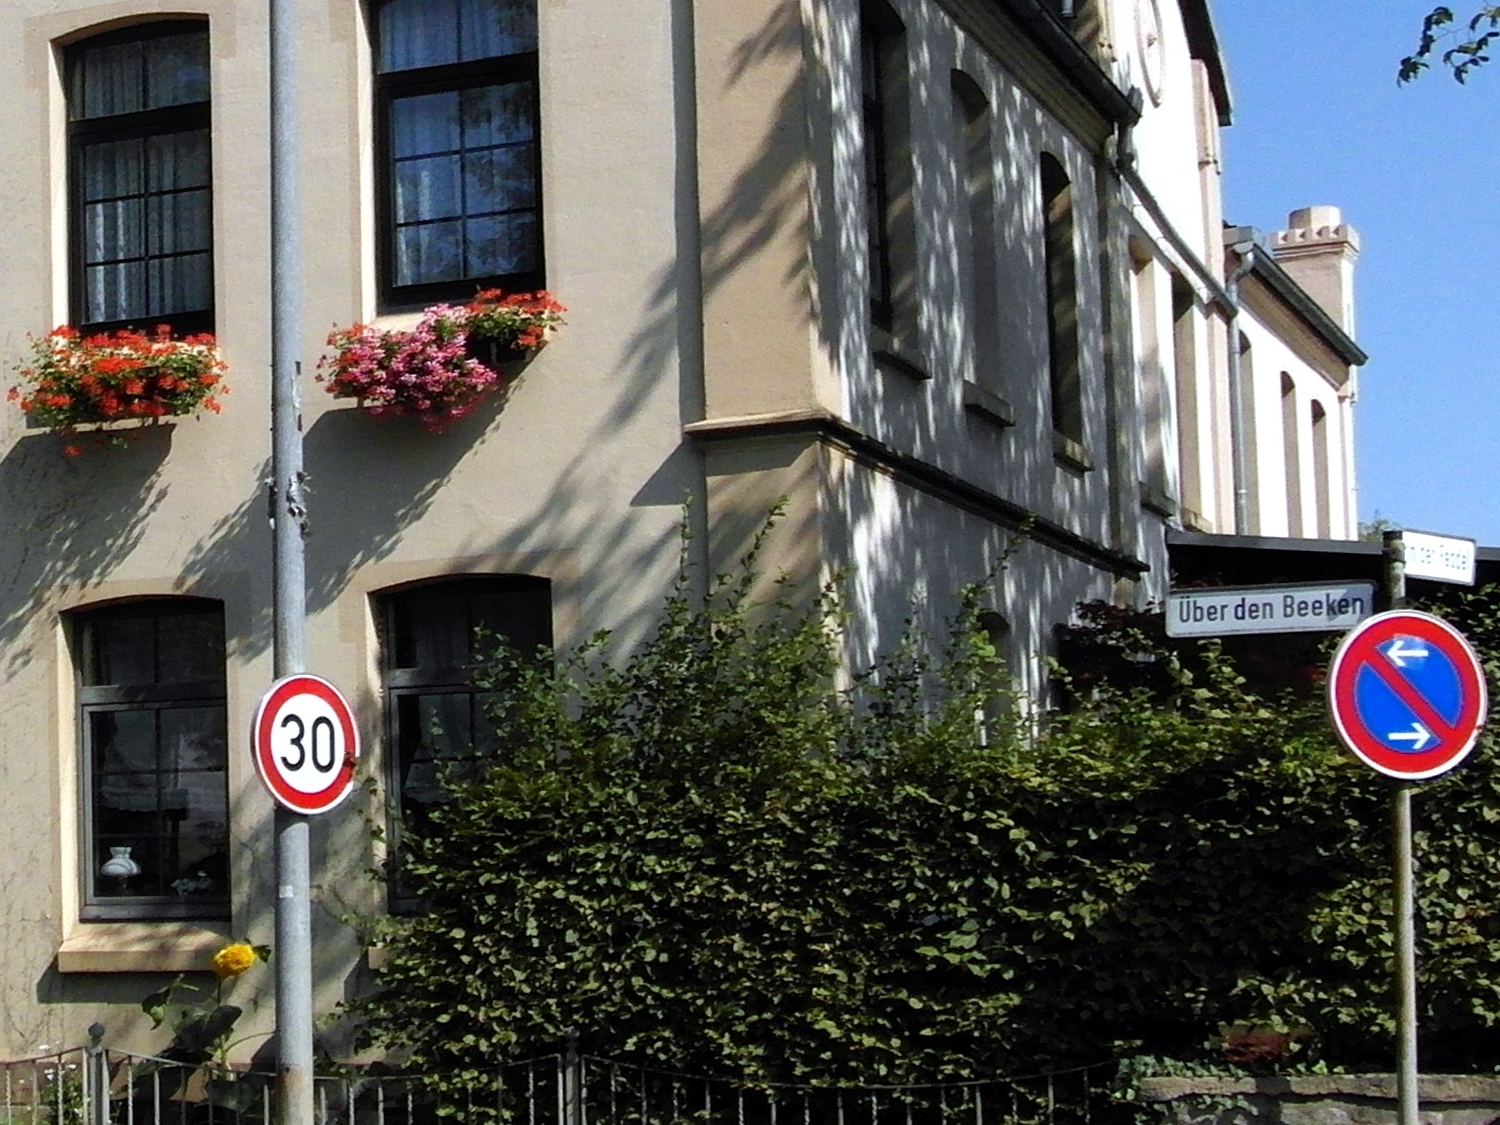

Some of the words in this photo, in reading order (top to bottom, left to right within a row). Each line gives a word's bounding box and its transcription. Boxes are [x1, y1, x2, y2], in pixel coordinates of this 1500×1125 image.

[1179, 595, 1229, 623] Über
[1233, 597, 1274, 620] den
[1283, 592, 1364, 618] Beeken
[280, 713, 336, 774] 30
